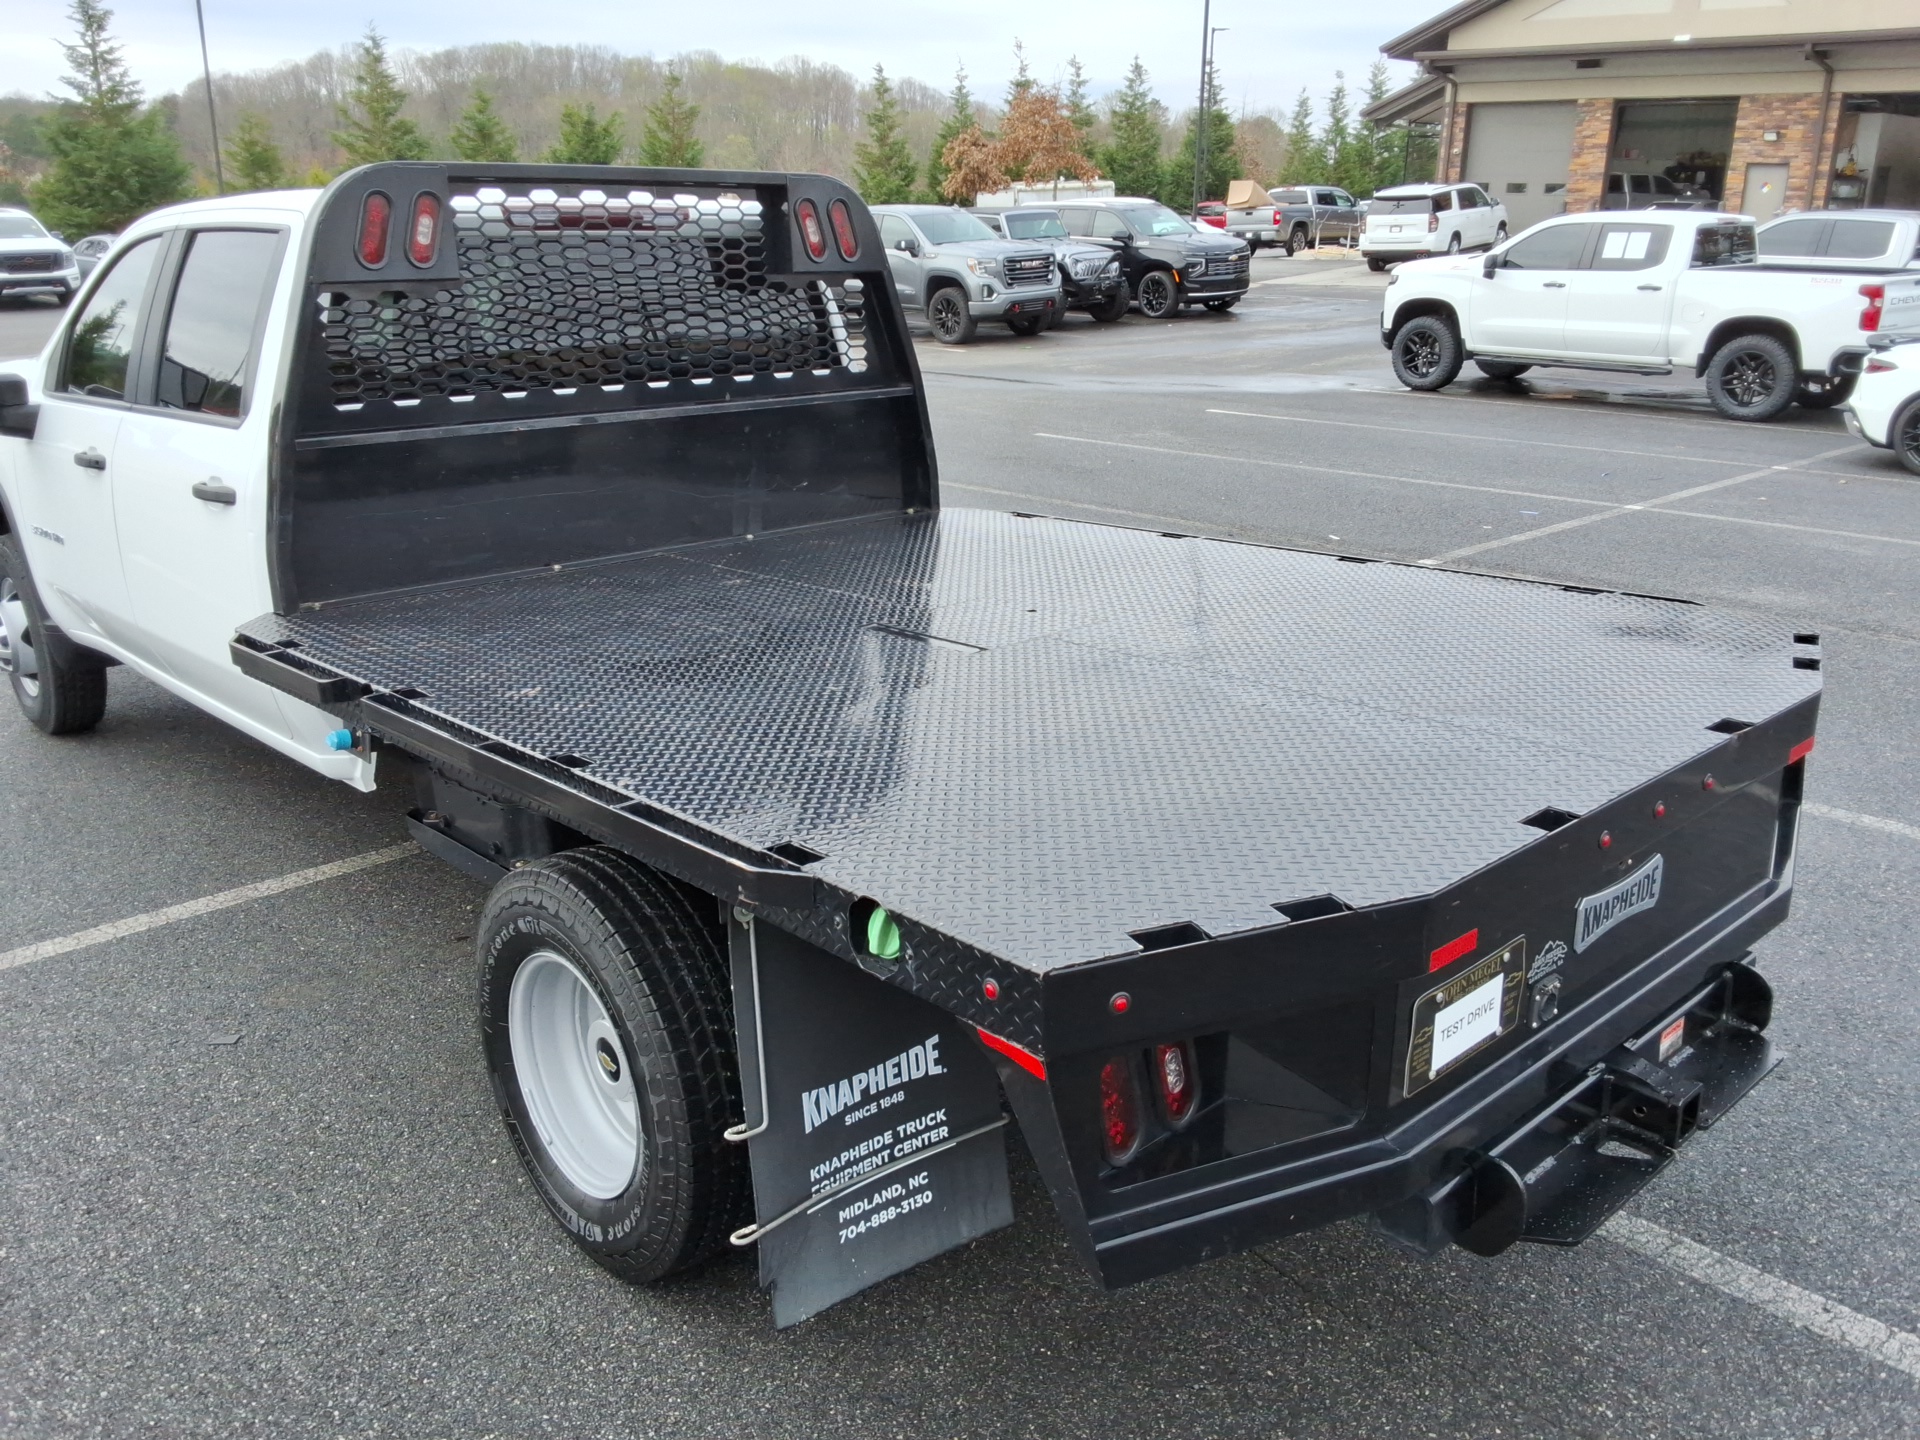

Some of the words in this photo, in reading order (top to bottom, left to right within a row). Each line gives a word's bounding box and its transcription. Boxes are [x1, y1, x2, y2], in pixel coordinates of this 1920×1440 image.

[1581, 865, 1659, 943] KNAPHEIDE
[1440, 977, 1468, 1008] JOHN
[1469, 957, 1502, 984] MEGEL
[1440, 1017, 1465, 1042] TEST
[1467, 997, 1495, 1027] DRIVE
[844, 1102, 878, 1126] SINCE
[879, 1090, 905, 1110] 1848
[809, 1130, 894, 1182] KNAPHEIDE
[896, 1108, 947, 1139] TRUCK
[811, 1149, 891, 1199] EQUIPMENT
[893, 1125, 949, 1157] CENTER
[838, 1183, 906, 1223] MIDLAND,
[908, 1171, 929, 1190] NC
[838, 1190, 933, 1244] 704-888-3130
